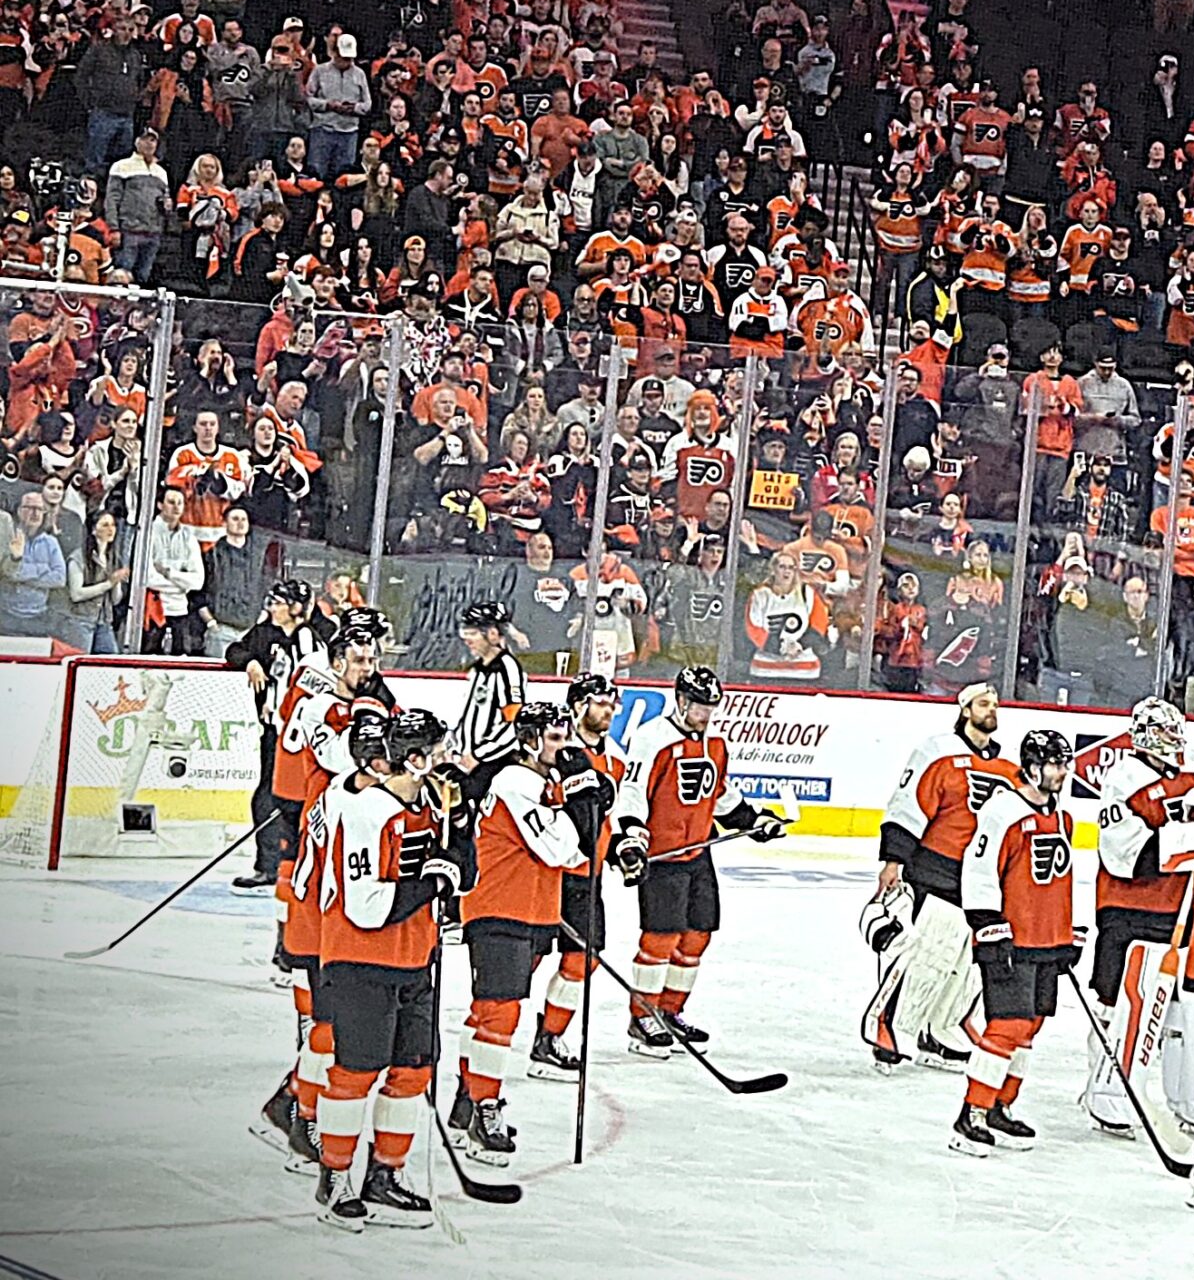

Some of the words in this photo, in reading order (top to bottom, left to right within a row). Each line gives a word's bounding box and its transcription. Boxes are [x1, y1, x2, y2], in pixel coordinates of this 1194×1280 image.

[752, 494, 793, 507] FLYERS
[764, 485, 780, 494] GO
[1100, 804, 1123, 829] 80
[974, 834, 989, 858] 9
[348, 848, 372, 881] 94
